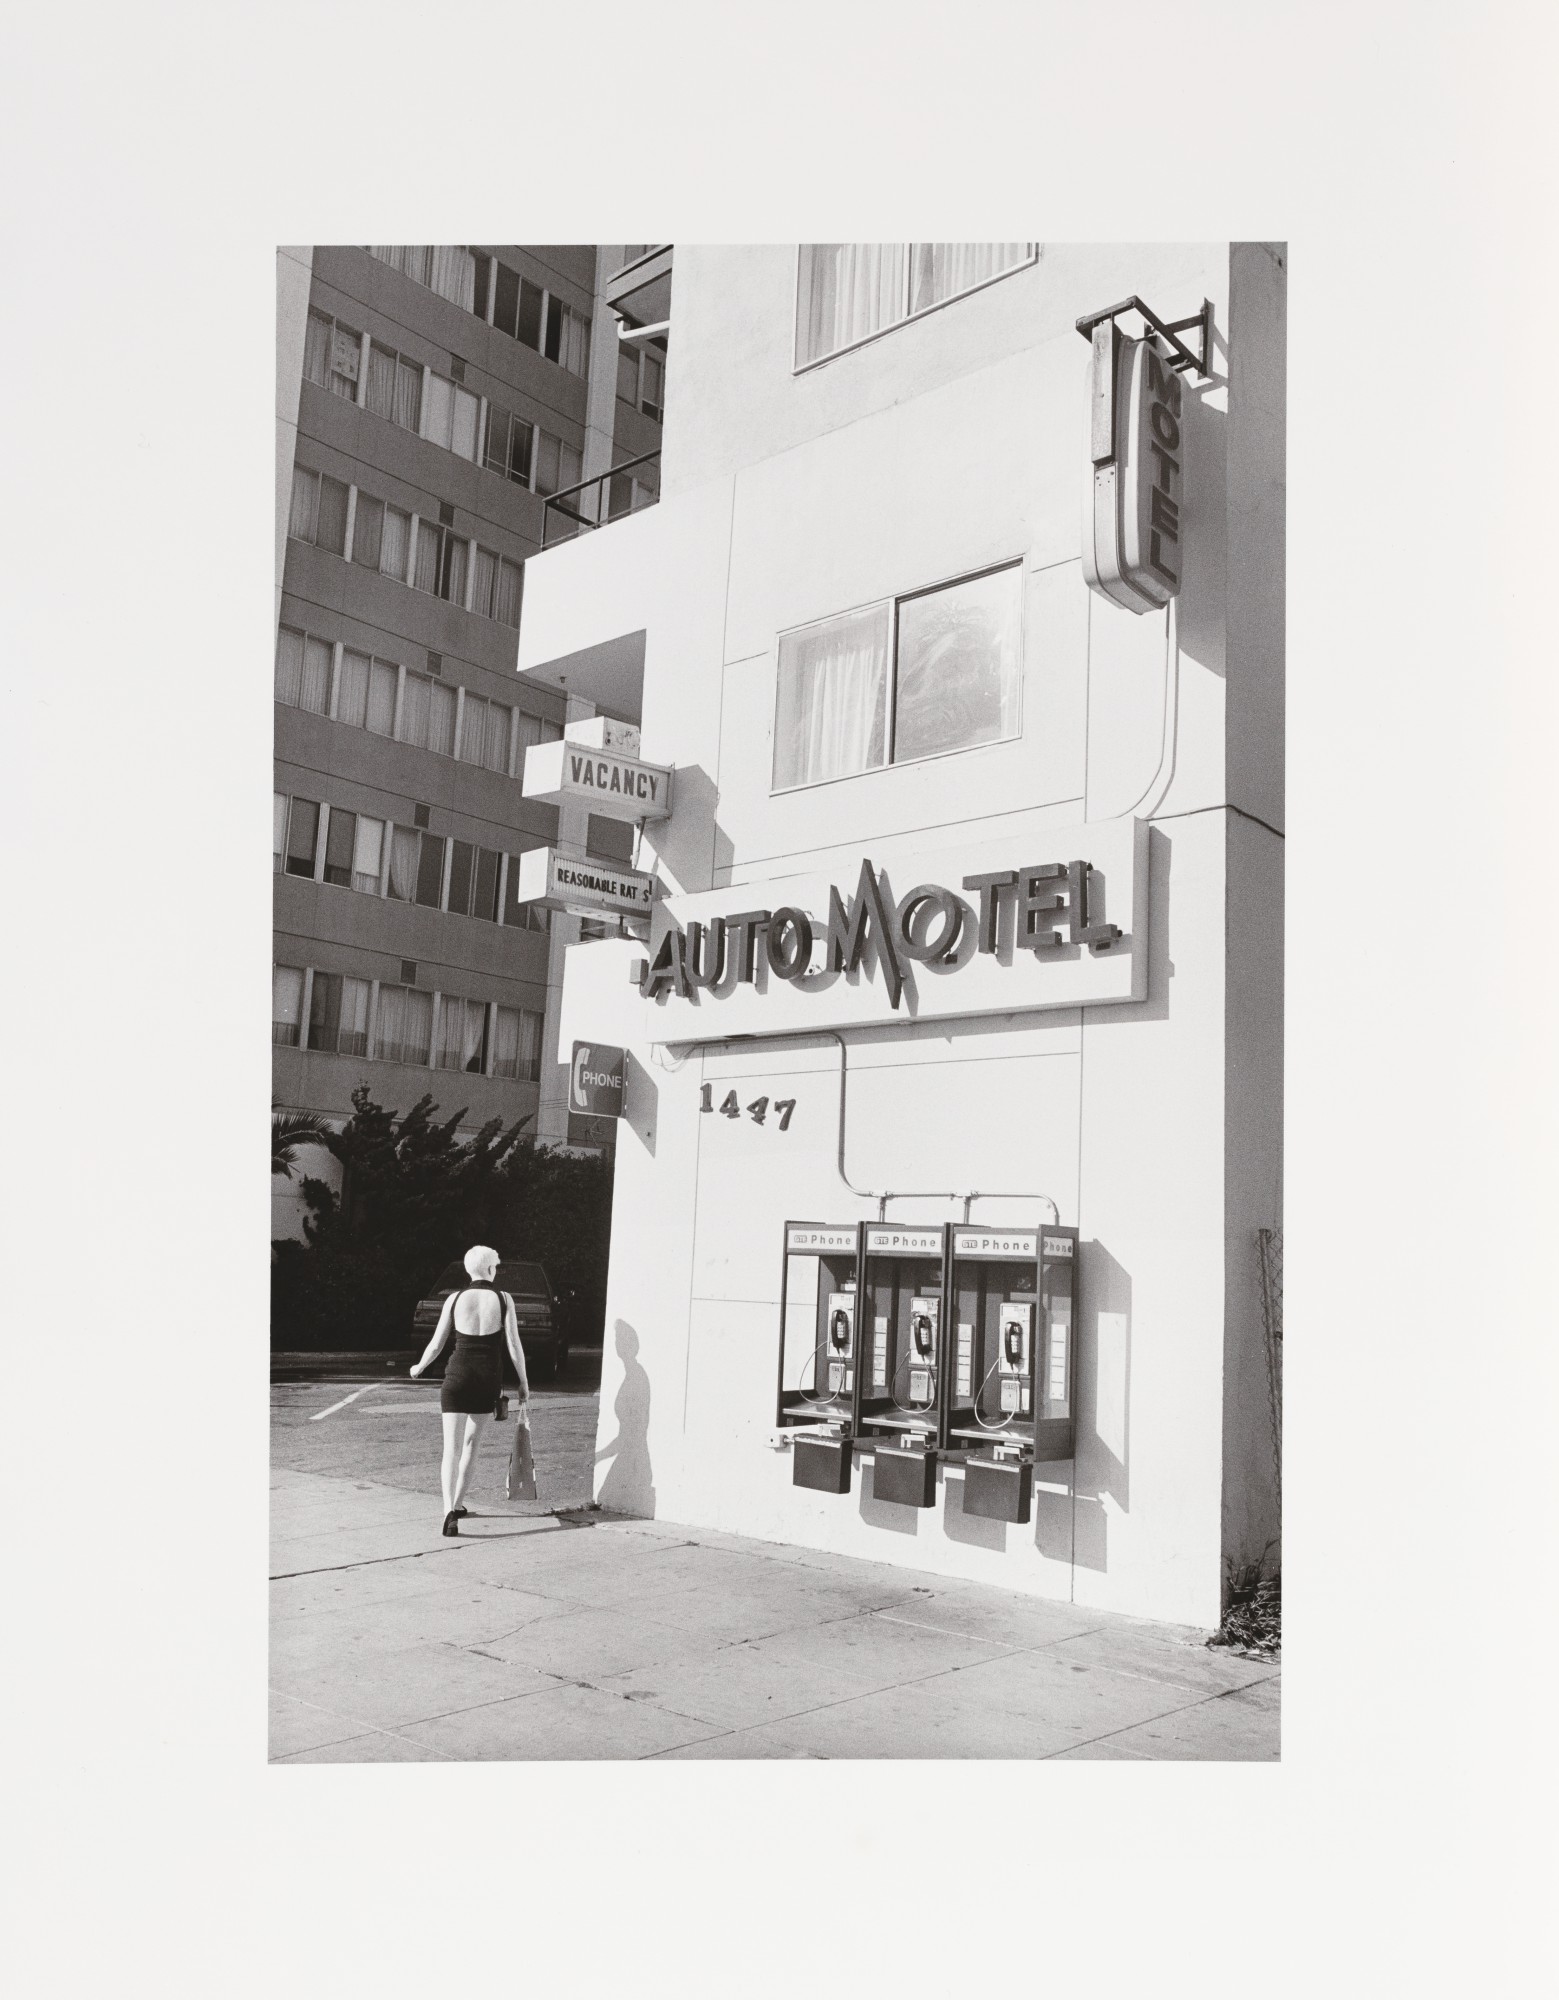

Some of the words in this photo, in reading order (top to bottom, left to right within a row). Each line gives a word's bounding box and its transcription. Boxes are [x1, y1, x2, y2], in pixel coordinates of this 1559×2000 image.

[1148, 347, 1182, 585] MOTEL
[571, 756, 660, 801] VACANCY
[557, 868, 617, 895] REASONABLE
[582, 1070, 622, 1089] PHONE
[700, 1082, 797, 1132] 1447
[811, 1235, 852, 1246] Phone
[892, 1236, 936, 1248] Phone
[982, 1239, 1030, 1251] Phone
[1044, 1240, 1073, 1254] Phone
